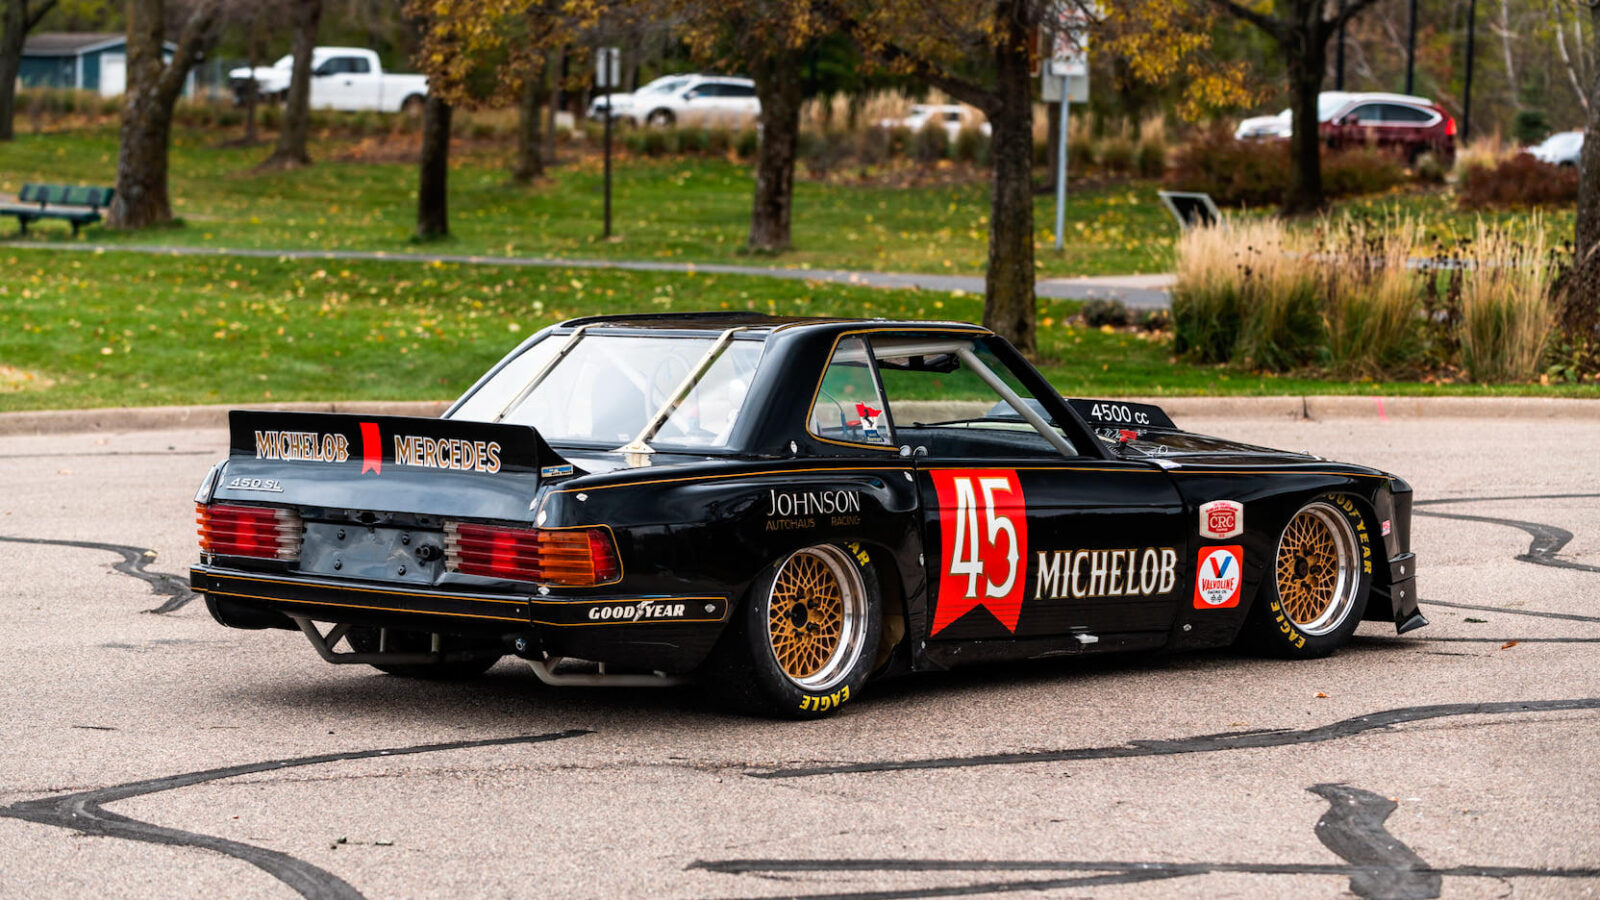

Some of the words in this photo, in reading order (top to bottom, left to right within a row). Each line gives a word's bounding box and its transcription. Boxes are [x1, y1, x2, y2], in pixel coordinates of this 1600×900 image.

[1091, 403, 1132, 423] 4500
[1134, 411, 1150, 425] cc
[254, 430, 349, 463] MICHELOB
[393, 434, 502, 474] MERCEDES
[230, 477, 262, 488] 450
[263, 479, 281, 489] SL
[766, 488, 861, 516] JOHNSON
[765, 517, 816, 532] AUTOHAUS
[831, 515, 861, 527] RACING
[1210, 515, 1234, 529] CRC
[1323, 493, 1373, 575] OODYEAR
[949, 476, 1020, 599] 45
[1033, 547, 1178, 600] MICHELOB
[1202, 577, 1236, 592] VALVOLINE
[588, 602, 686, 621] GOODYEAR
[1270, 599, 1306, 649] EAGLE
[799, 684, 850, 712] EAGLE
